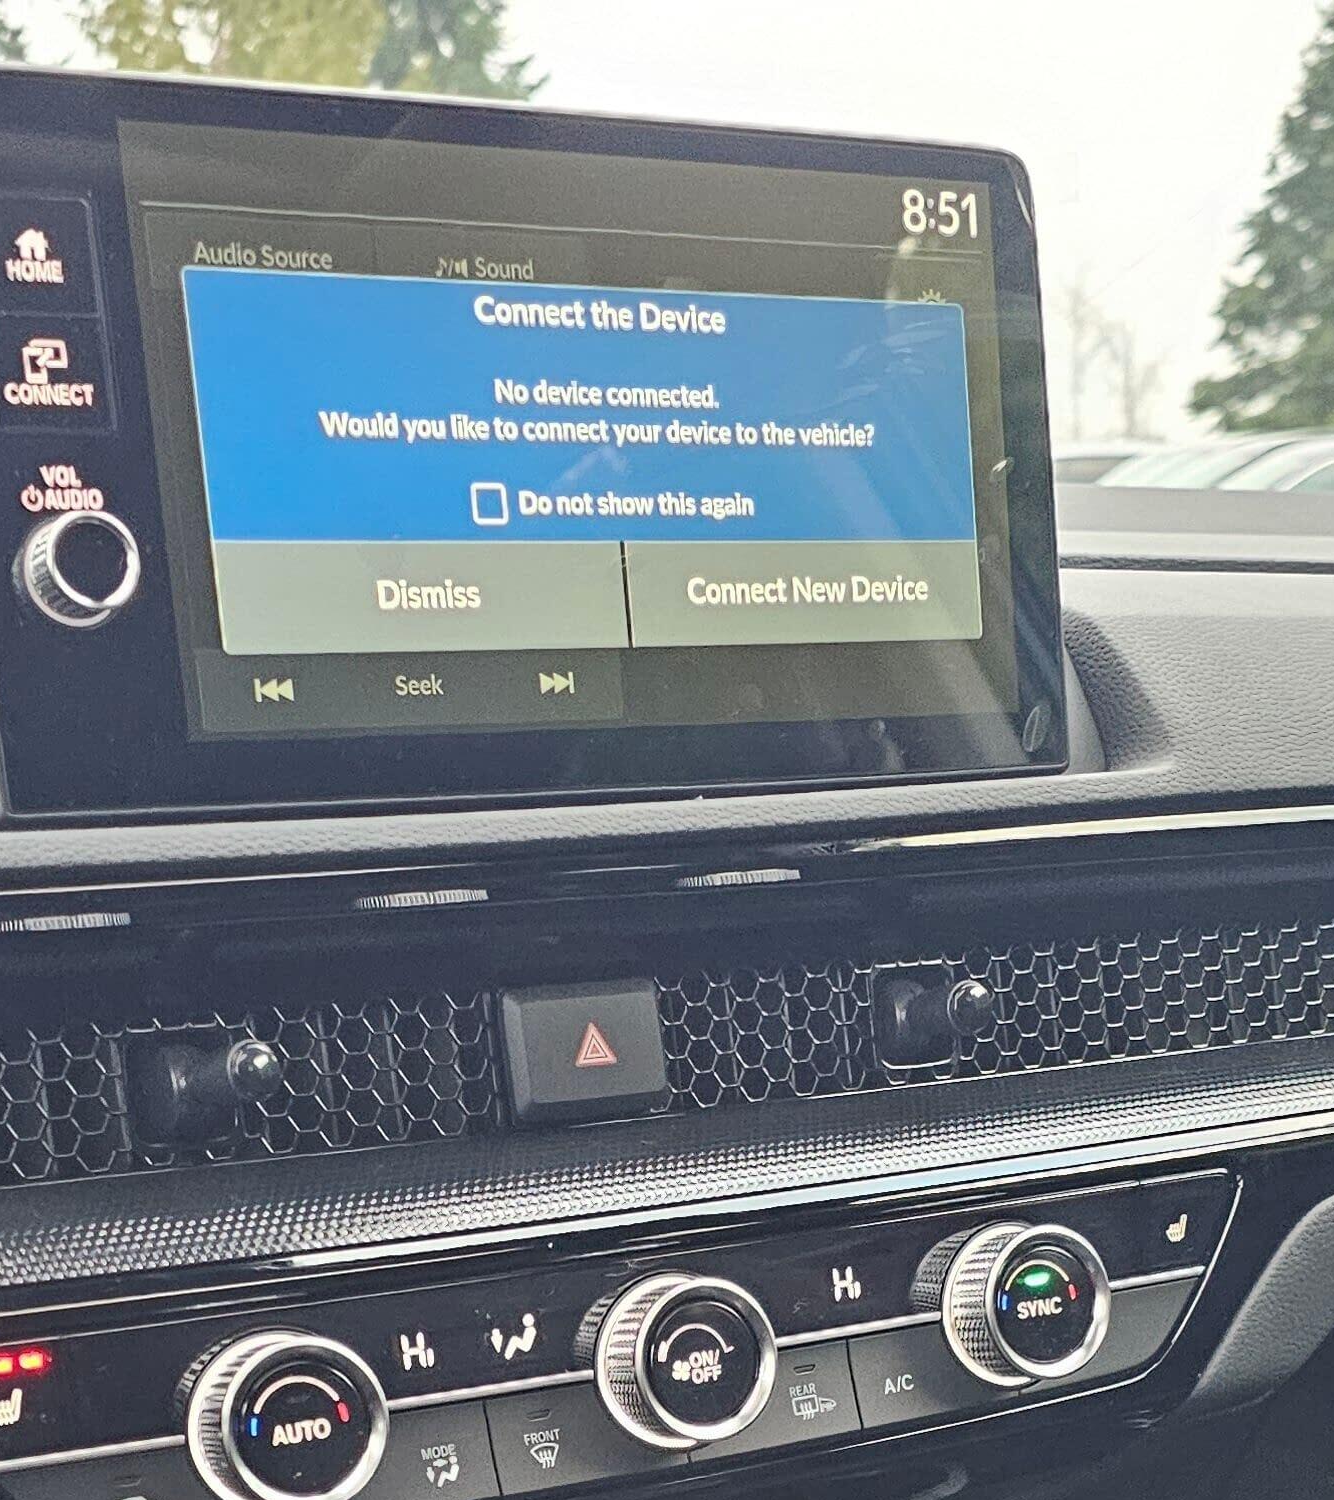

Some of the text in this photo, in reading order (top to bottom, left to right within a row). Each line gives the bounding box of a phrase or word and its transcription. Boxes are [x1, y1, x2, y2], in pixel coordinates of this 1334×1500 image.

[902, 188, 978, 239] 8:51
[193, 241, 334, 270] Audio Source
[5, 258, 65, 284] HOME
[474, 257, 535, 281] Sound
[473, 295, 726, 334] Connect the Device
[3, 382, 95, 407] CONNECT
[493, 378, 720, 409] No device connected.
[318, 410, 875, 448] Would you like to connect your device to the vehicle?
[39, 464, 83, 489] VOL
[44, 486, 105, 512] AUDIO
[518, 489, 755, 521] Do not show this again
[376, 578, 483, 610] Dismiss
[686, 575, 929, 606] Connect New Device
[394, 673, 445, 697] Seek
[1016, 1295, 1064, 1321] SYNC
[688, 1348, 721, 1369] ON/
[691, 1363, 723, 1385] OFF
[883, 1373, 915, 1396] A/C
[788, 1382, 817, 1398] REAR
[271, 1417, 332, 1447] AUTO
[523, 1427, 562, 1447] FRONT
[420, 1443, 458, 1461] MODE
